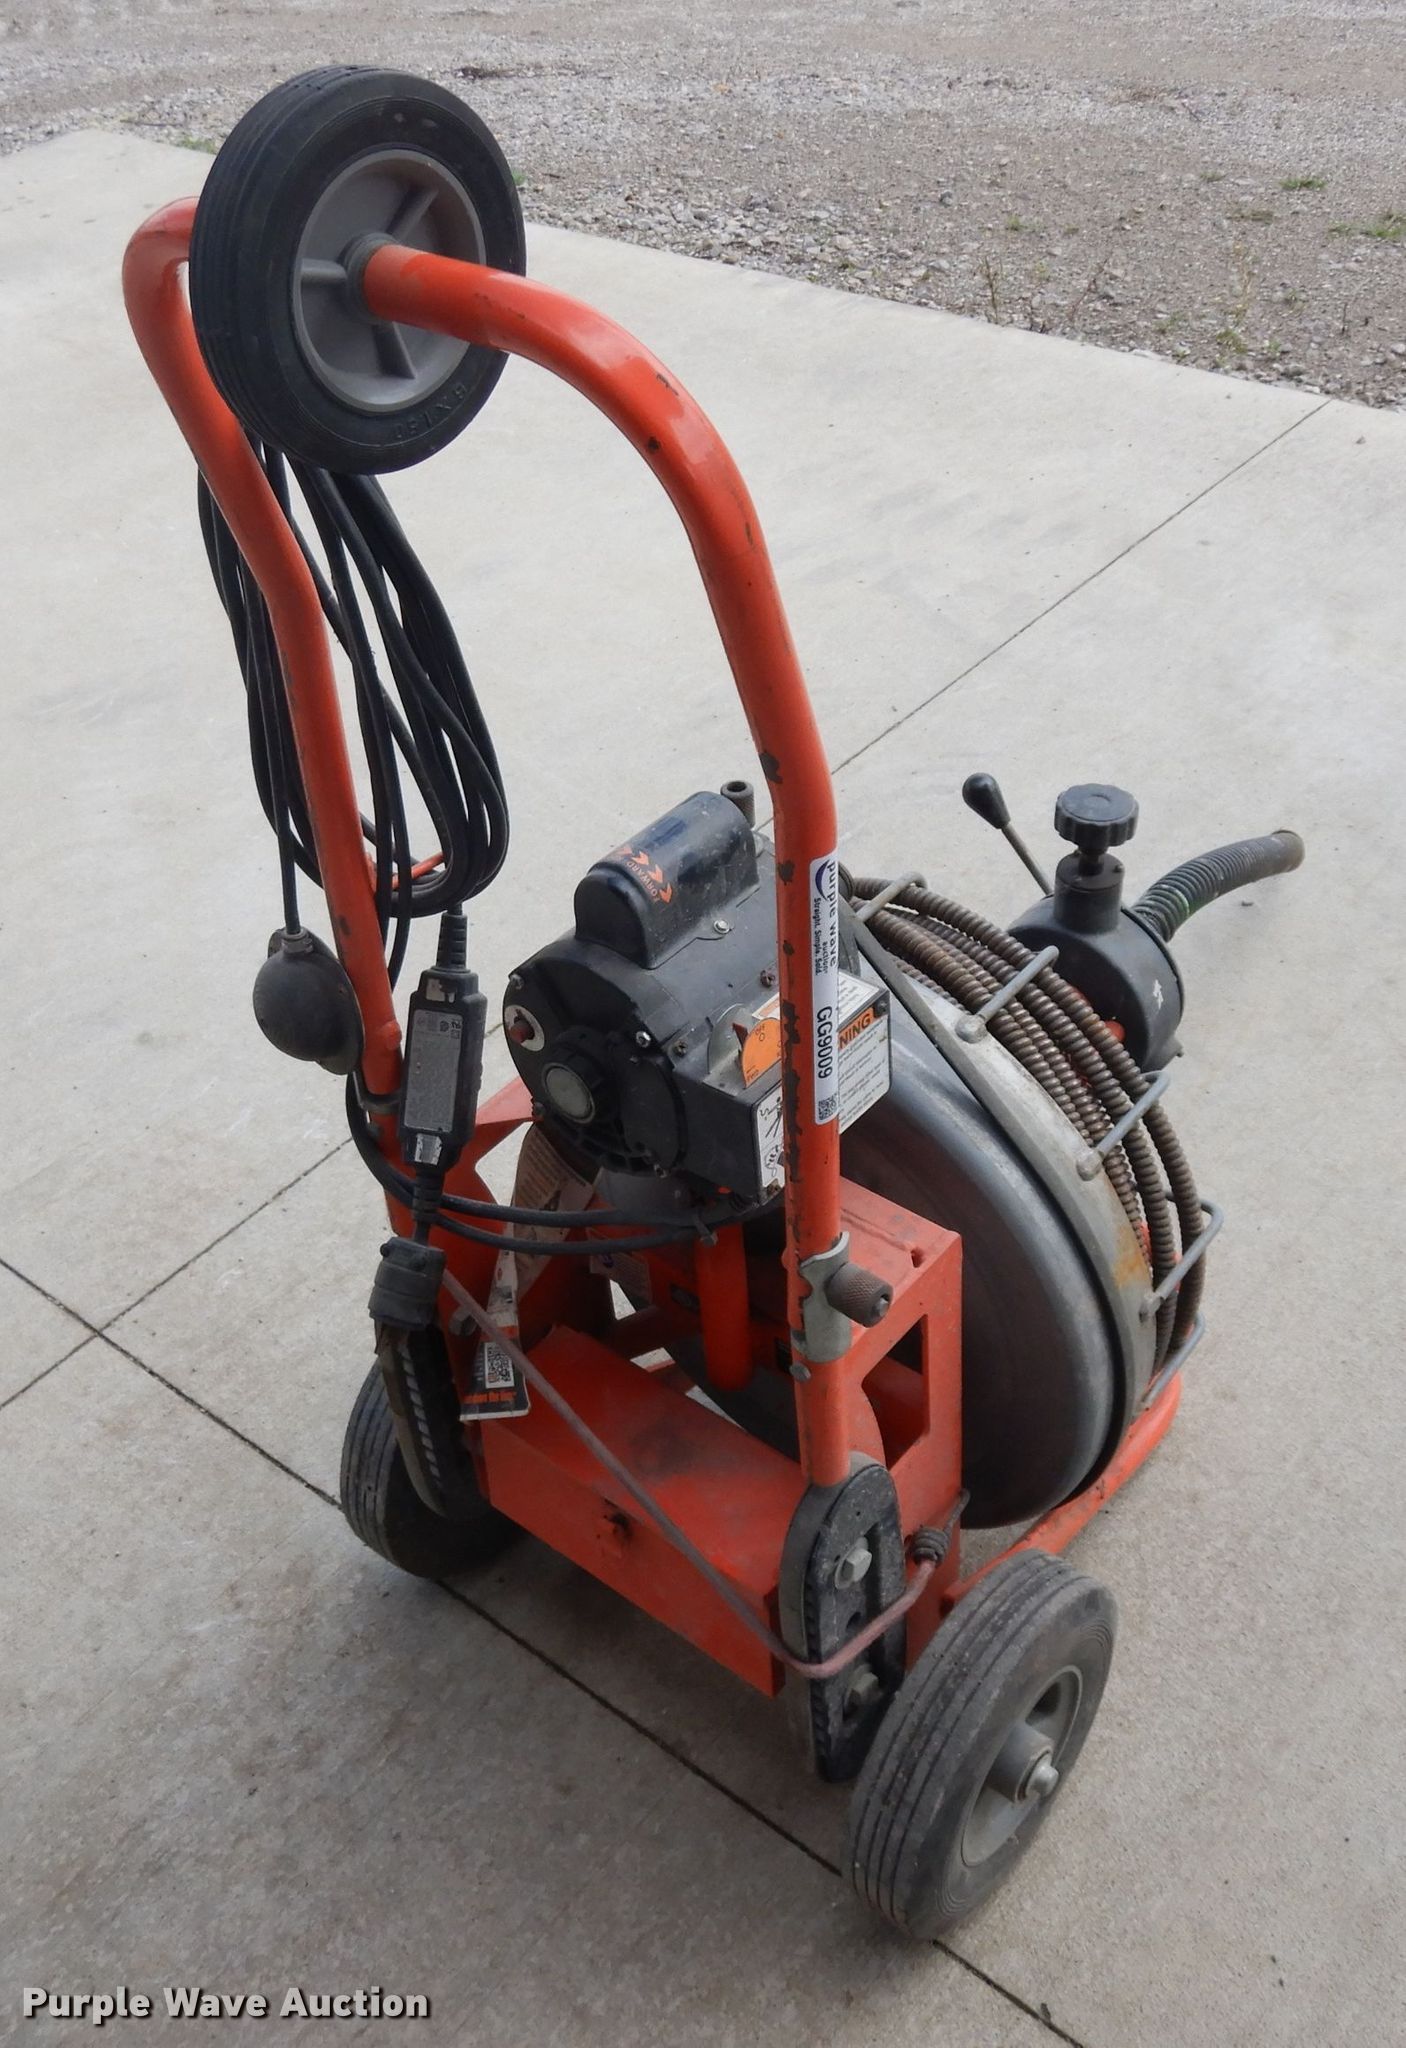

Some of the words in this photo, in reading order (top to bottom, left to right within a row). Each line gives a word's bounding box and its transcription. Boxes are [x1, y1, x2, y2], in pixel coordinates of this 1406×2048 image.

[826, 861, 838, 918] purple
[829, 923, 838, 967] wave
[815, 1006, 834, 1080] GG9009
[838, 1013, 872, 1050] NING
